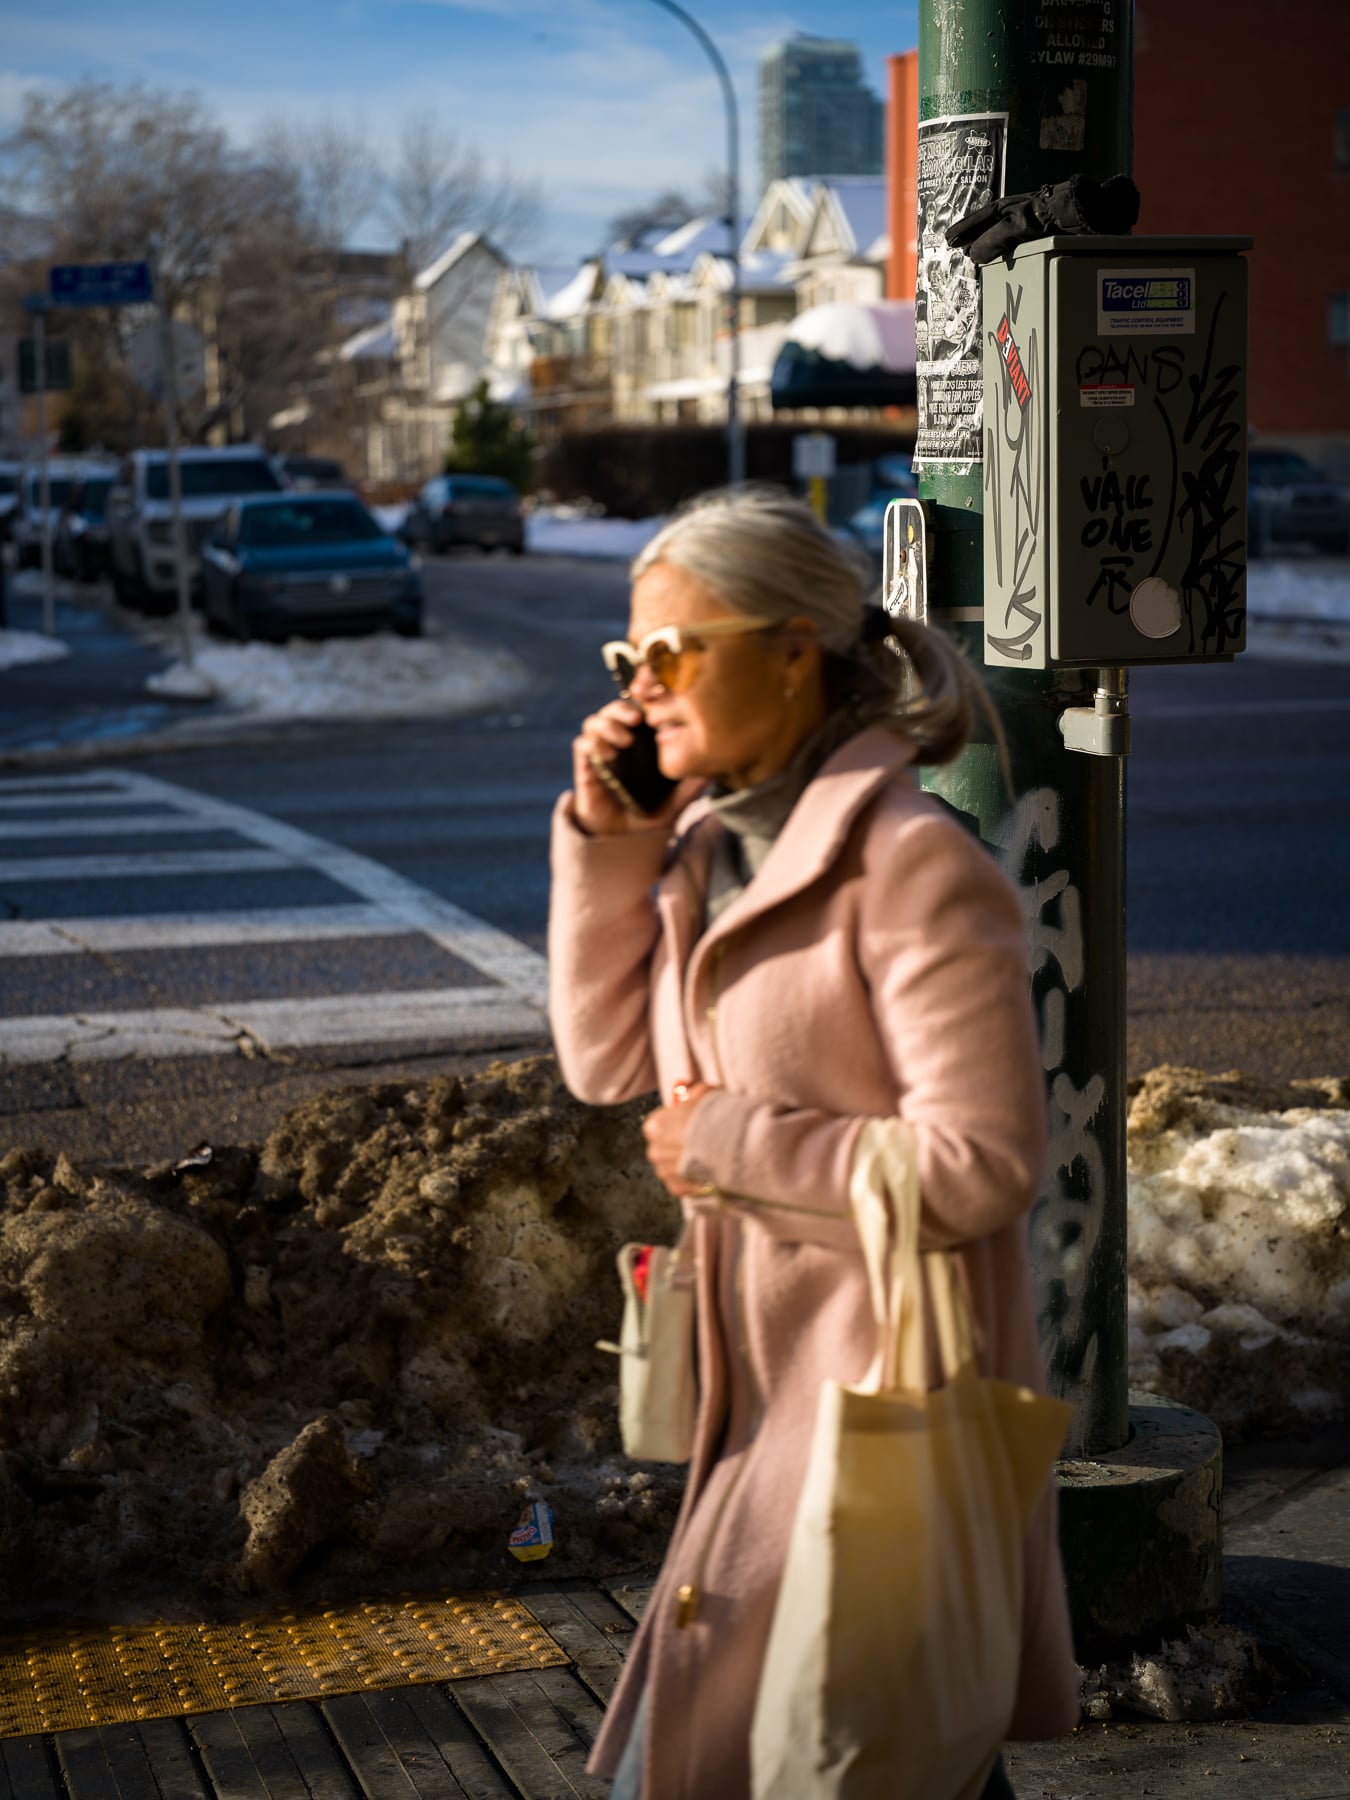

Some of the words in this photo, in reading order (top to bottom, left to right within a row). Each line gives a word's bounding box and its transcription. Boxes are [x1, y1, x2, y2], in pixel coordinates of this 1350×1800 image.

[1046, 33, 1105, 50] ALLOD
[1104, 280, 1150, 299] Tacel
[997, 317, 1031, 408] DEVIANT
[1082, 516, 1153, 552] ONE
